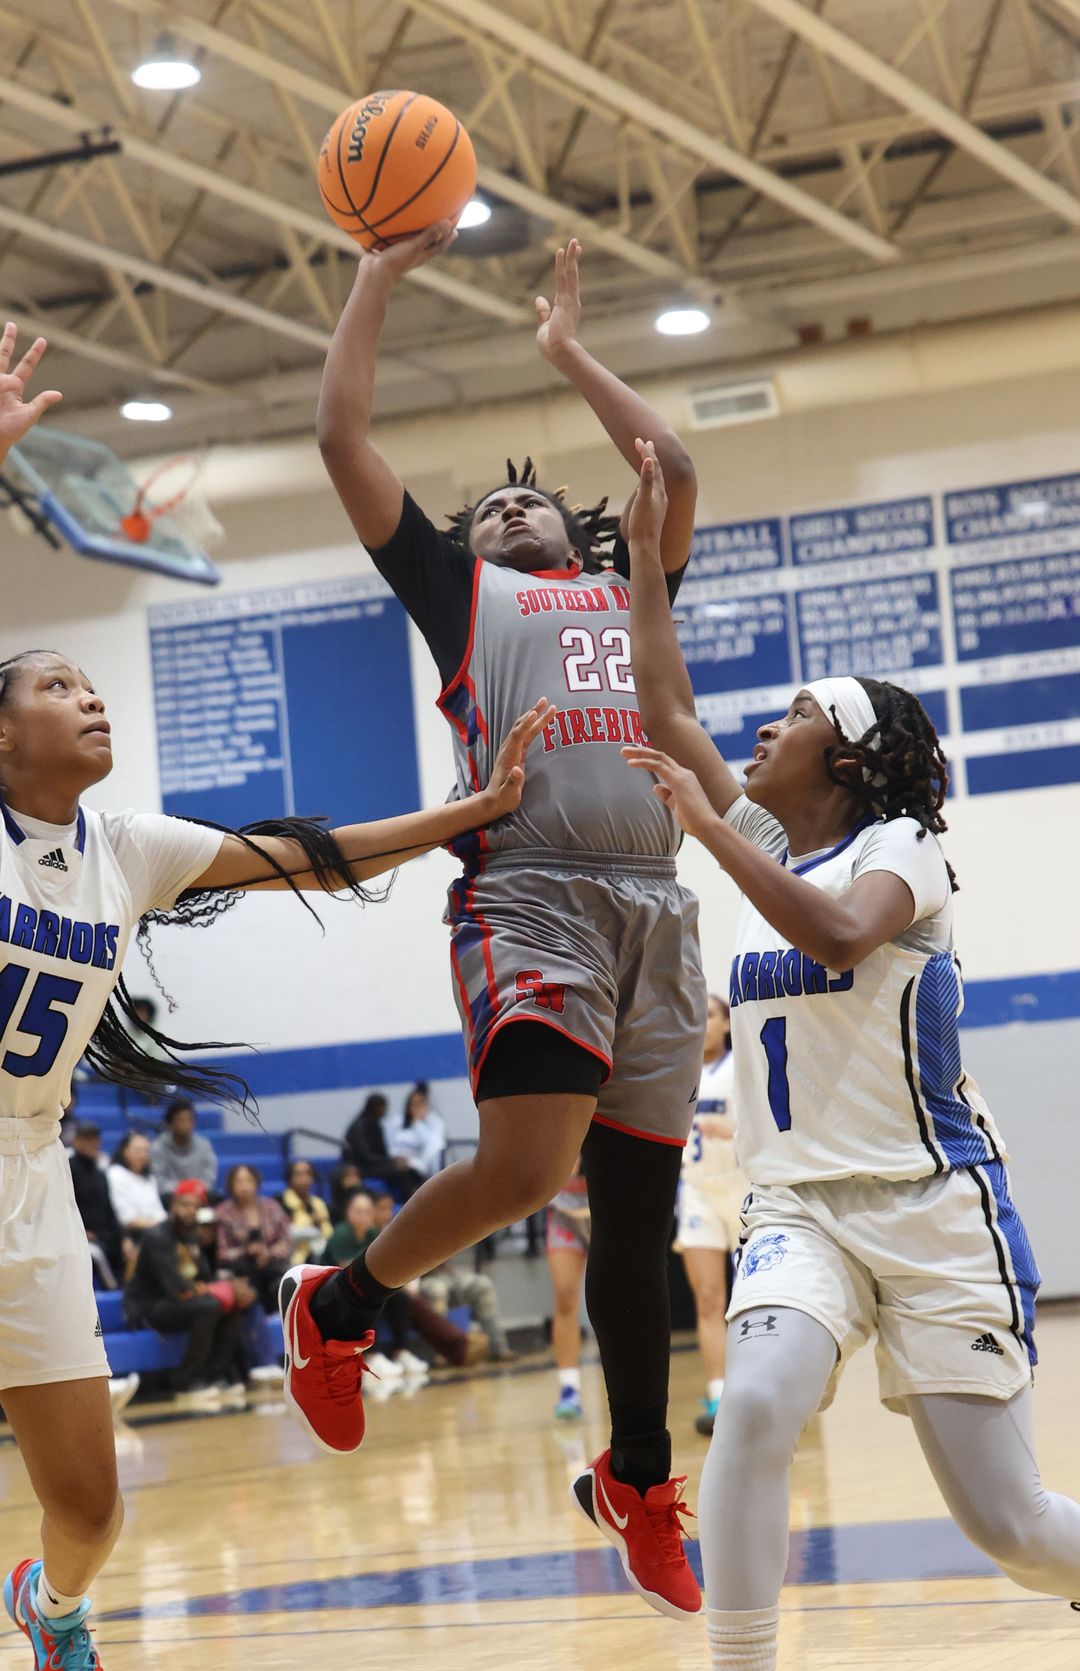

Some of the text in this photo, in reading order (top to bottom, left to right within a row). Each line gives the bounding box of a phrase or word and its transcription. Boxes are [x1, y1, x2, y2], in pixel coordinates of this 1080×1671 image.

[515, 586, 610, 617] SOUTHERN
[559, 626, 636, 694] 22
[542, 706, 653, 753] FIREBIR
[38, 858, 69, 873] adidas
[0, 893, 119, 971] ARRIORS
[730, 948, 854, 1008] ARRIORS
[0, 963, 83, 1078] 15
[760, 1016, 792, 1132] 1
[971, 1342, 1005, 1356] adidas
